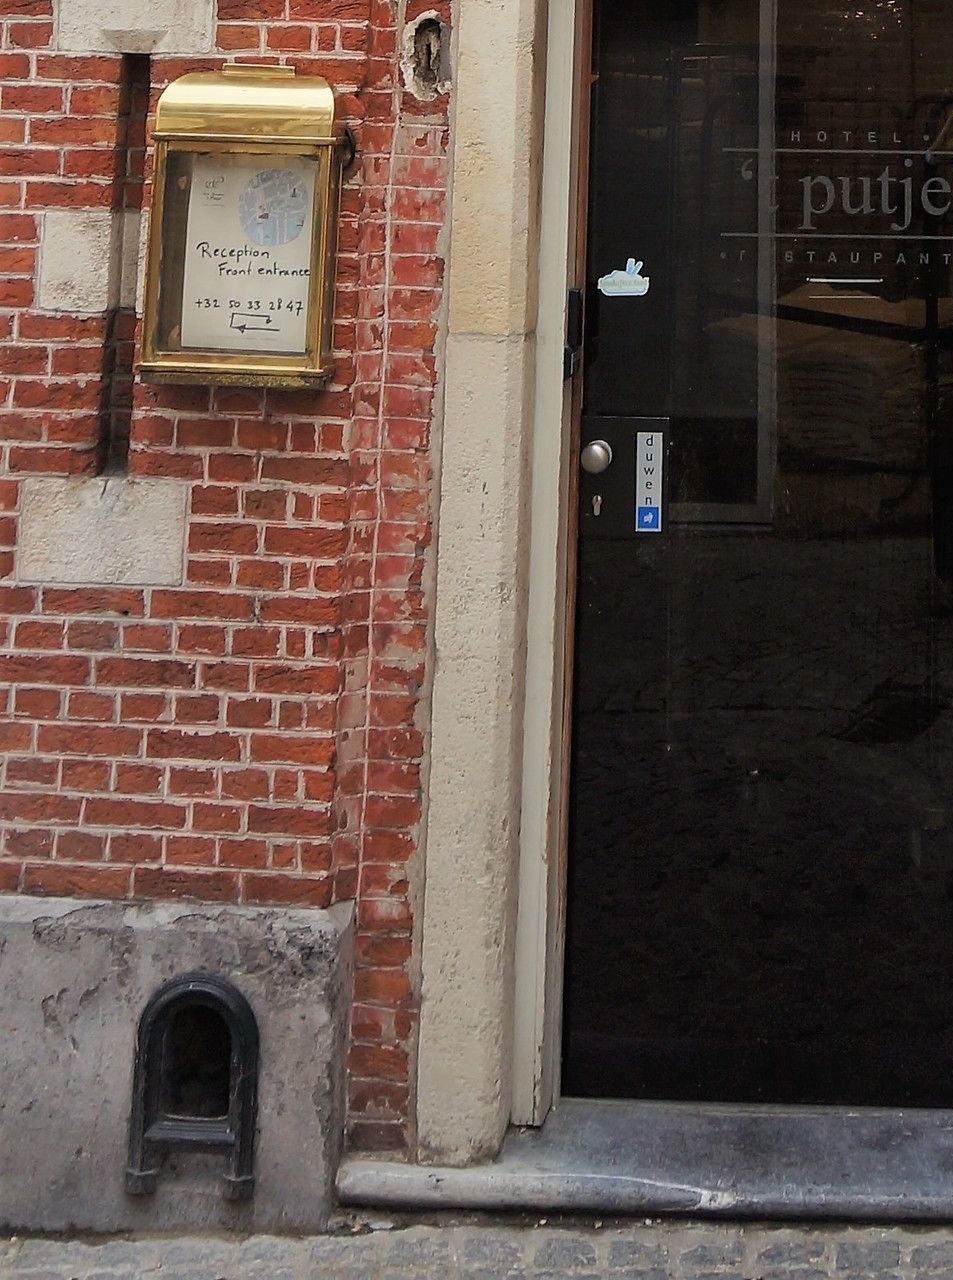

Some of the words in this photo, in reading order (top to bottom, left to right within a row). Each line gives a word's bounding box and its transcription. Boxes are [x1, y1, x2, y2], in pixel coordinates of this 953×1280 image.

[790, 130, 902, 144] HOTEL
[797, 158, 952, 232] putje
[196, 241, 270, 263] Reception
[738, 249, 952, 265] RSTAURANT
[218, 261, 252, 276] Front
[257, 262, 311, 277] entrance
[195, 299, 220, 309] +32
[228, 300, 241, 309] 50
[247, 301, 261, 310] 33
[269, 298, 283, 311] 28
[286, 300, 304, 316] 47
[643, 435, 655, 506] duwen
